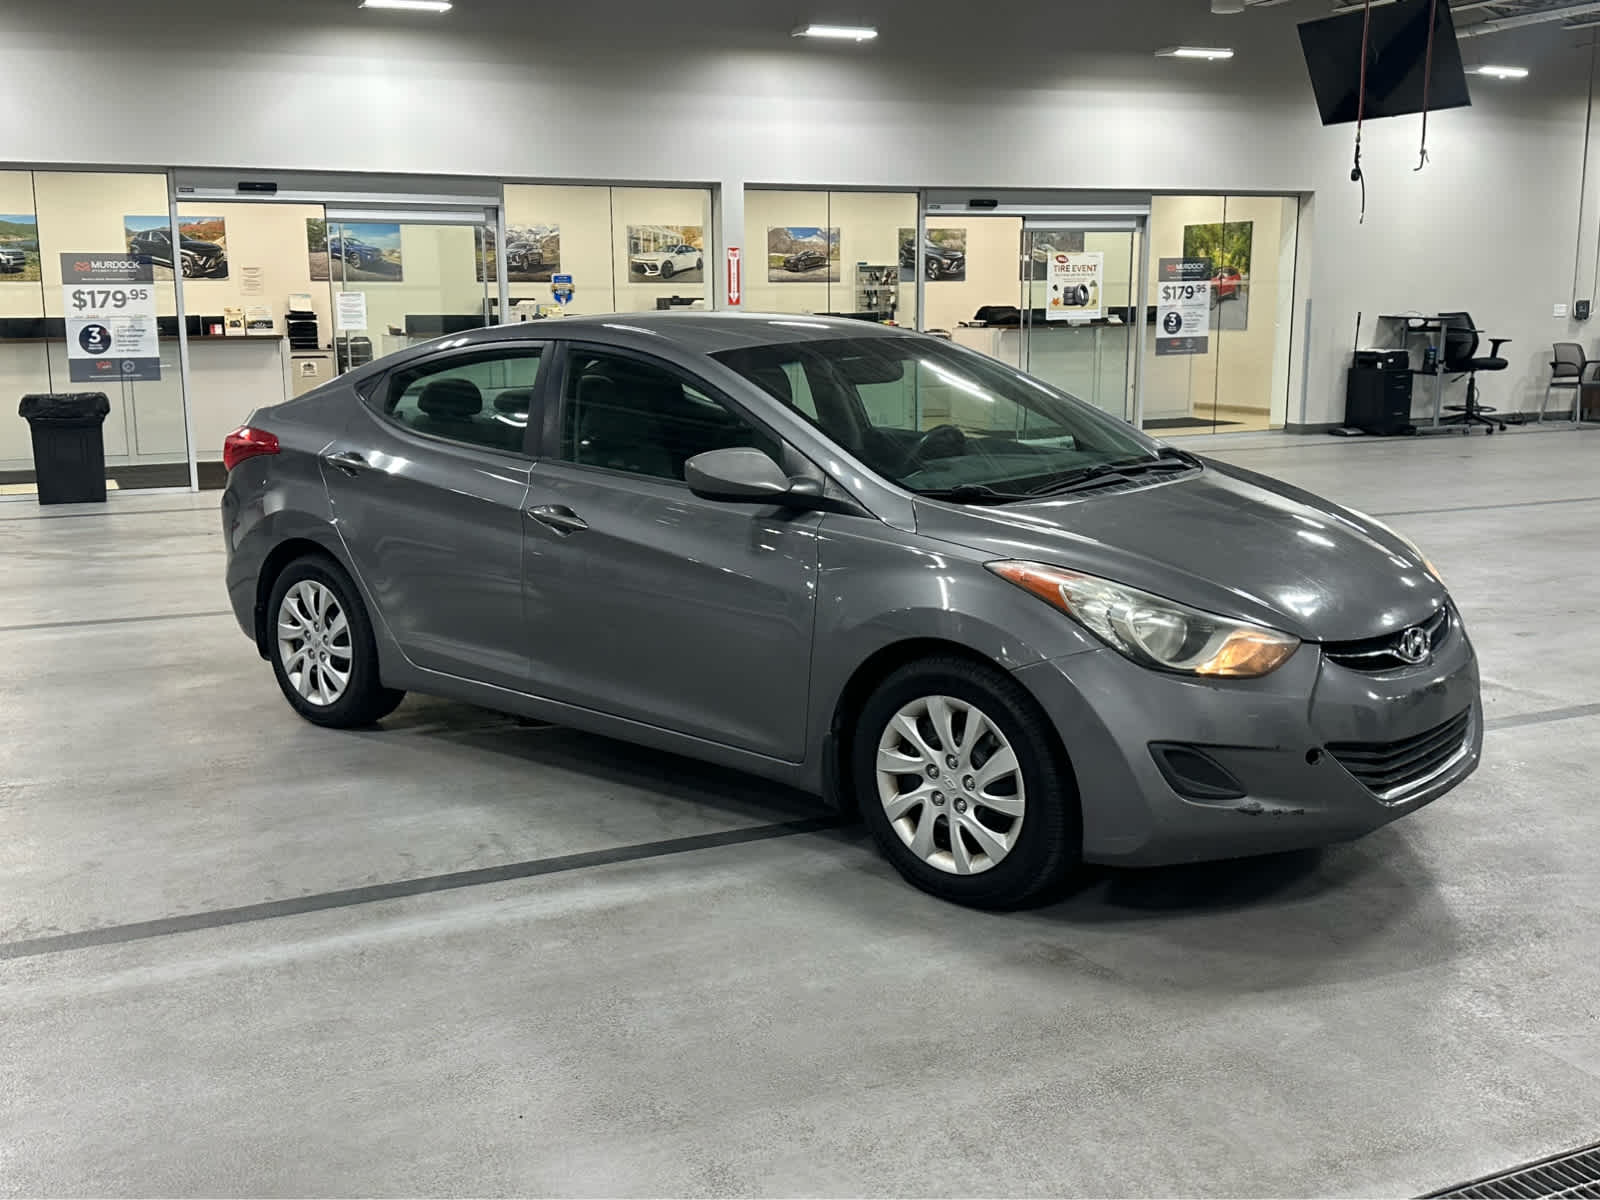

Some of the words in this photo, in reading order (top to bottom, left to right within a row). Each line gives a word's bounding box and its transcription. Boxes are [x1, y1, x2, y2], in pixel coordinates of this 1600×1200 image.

[90, 260, 141, 269] MURDOCK
[1053, 264, 1071, 272] TIRE
[1072, 264, 1097, 272] EVENT
[1168, 313, 1177, 326] 3
[88, 327, 102, 344] 3
